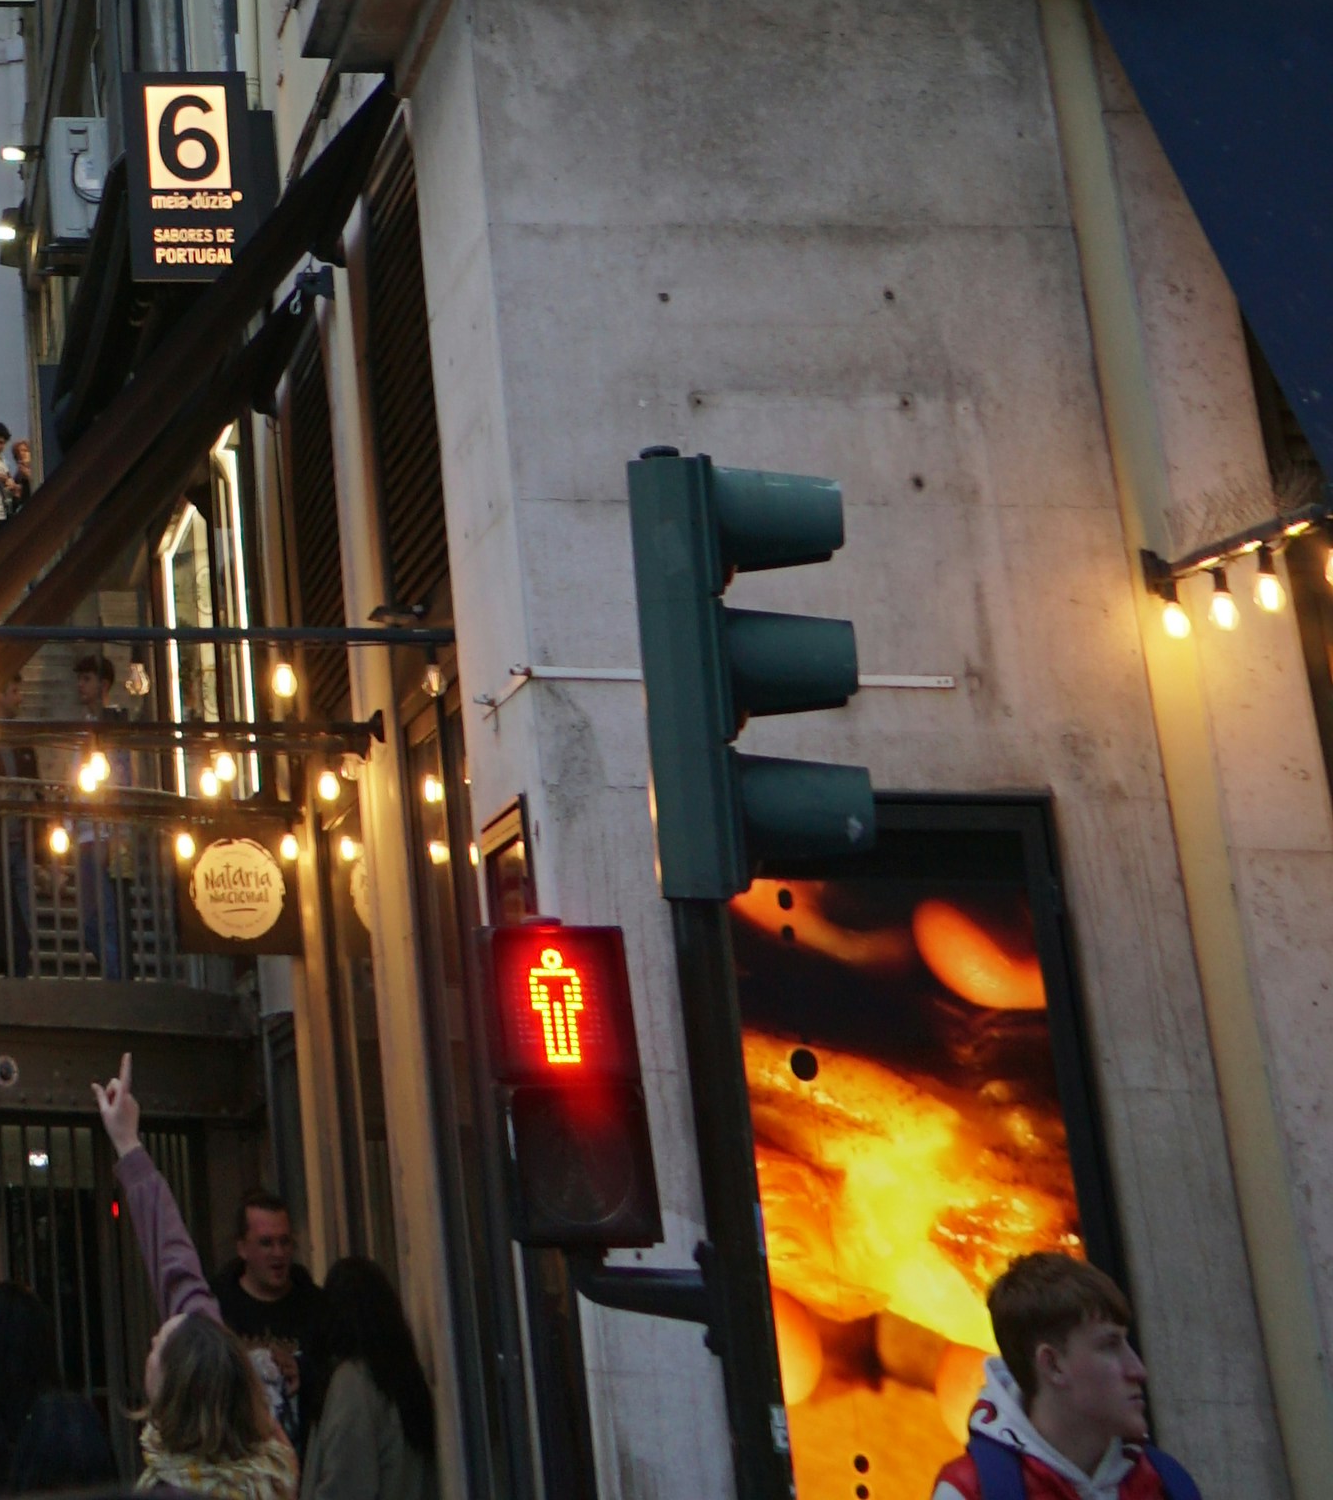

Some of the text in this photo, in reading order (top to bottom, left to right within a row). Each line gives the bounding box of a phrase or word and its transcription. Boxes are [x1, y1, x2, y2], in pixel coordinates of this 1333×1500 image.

[158, 94, 220, 182] 6
[153, 229, 235, 243] SABORES DE
[155, 248, 233, 264] PORTUGAL
[204, 863, 273, 890] Nataria
